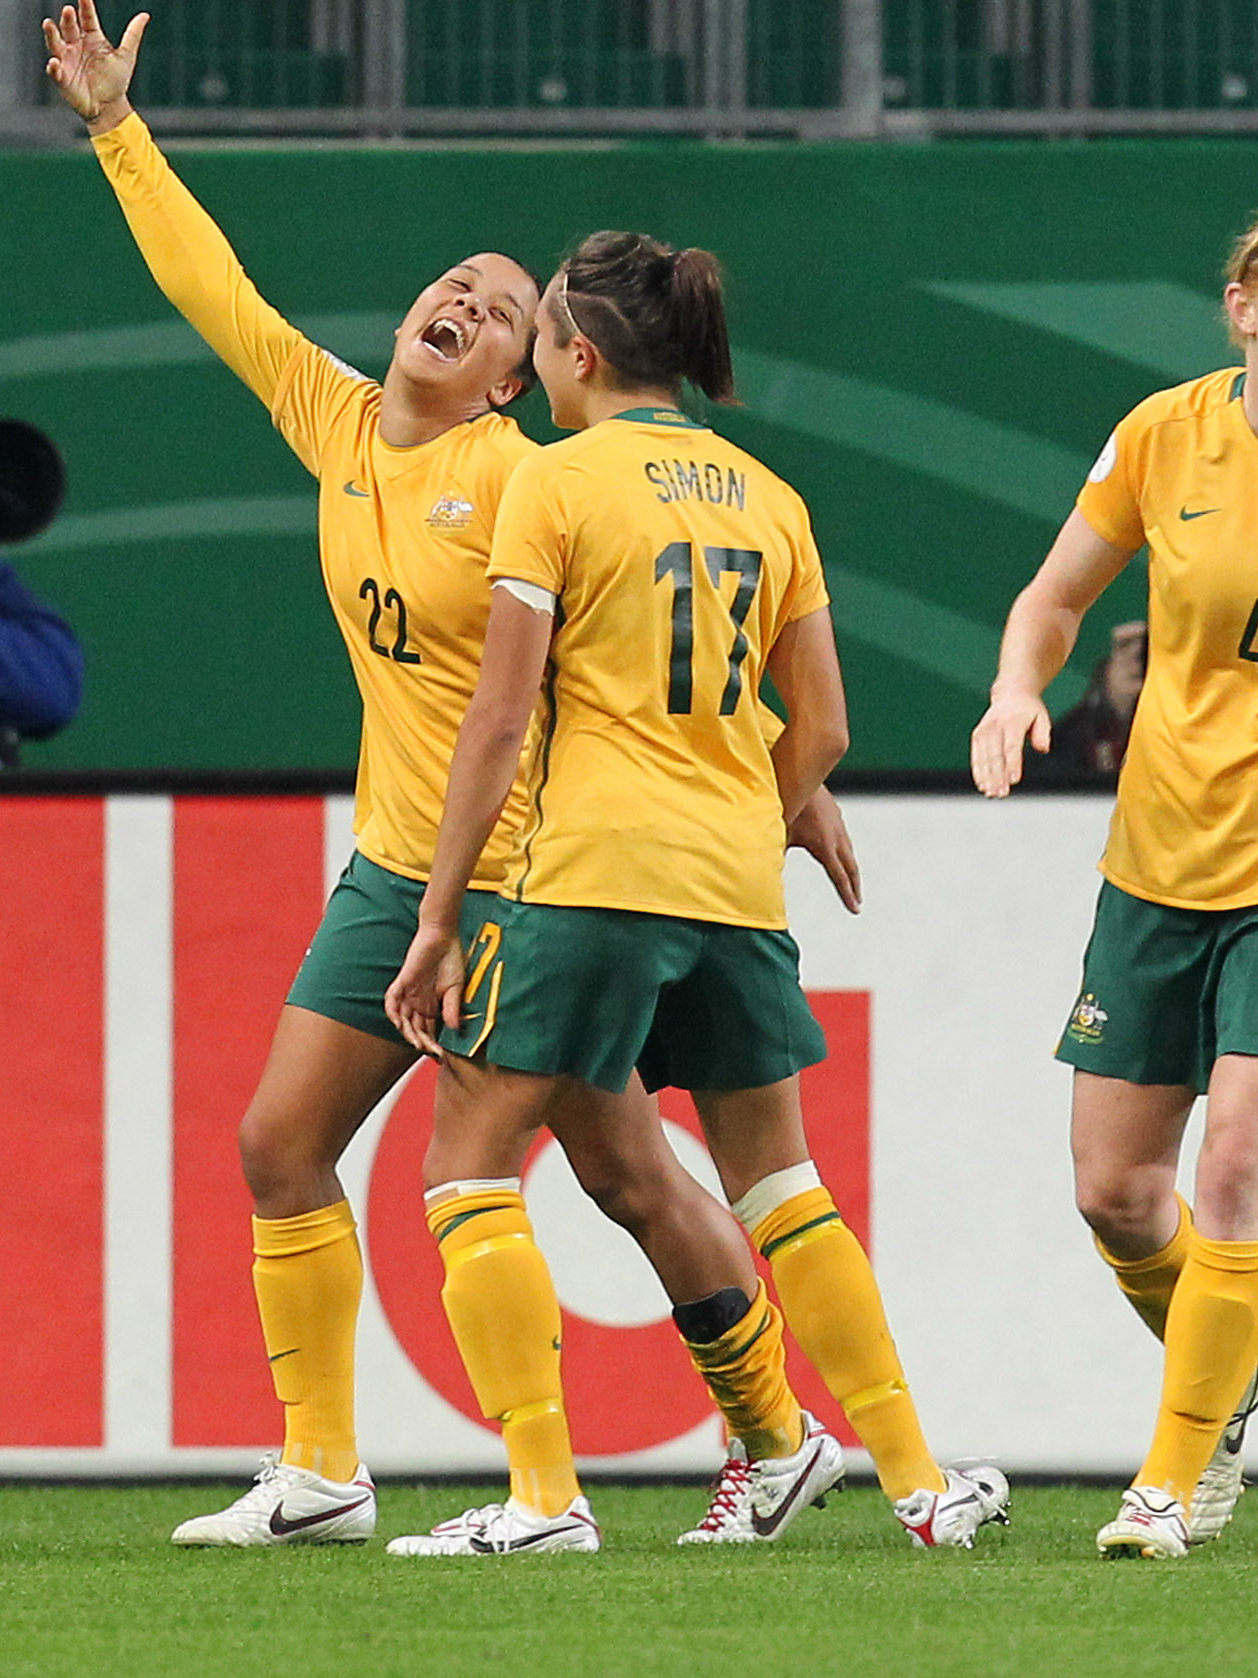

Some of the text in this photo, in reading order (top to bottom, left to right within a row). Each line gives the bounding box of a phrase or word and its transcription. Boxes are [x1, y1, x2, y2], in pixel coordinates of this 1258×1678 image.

[645, 459, 745, 511] SIMON
[359, 577, 421, 664] 22
[654, 542, 763, 716] 17
